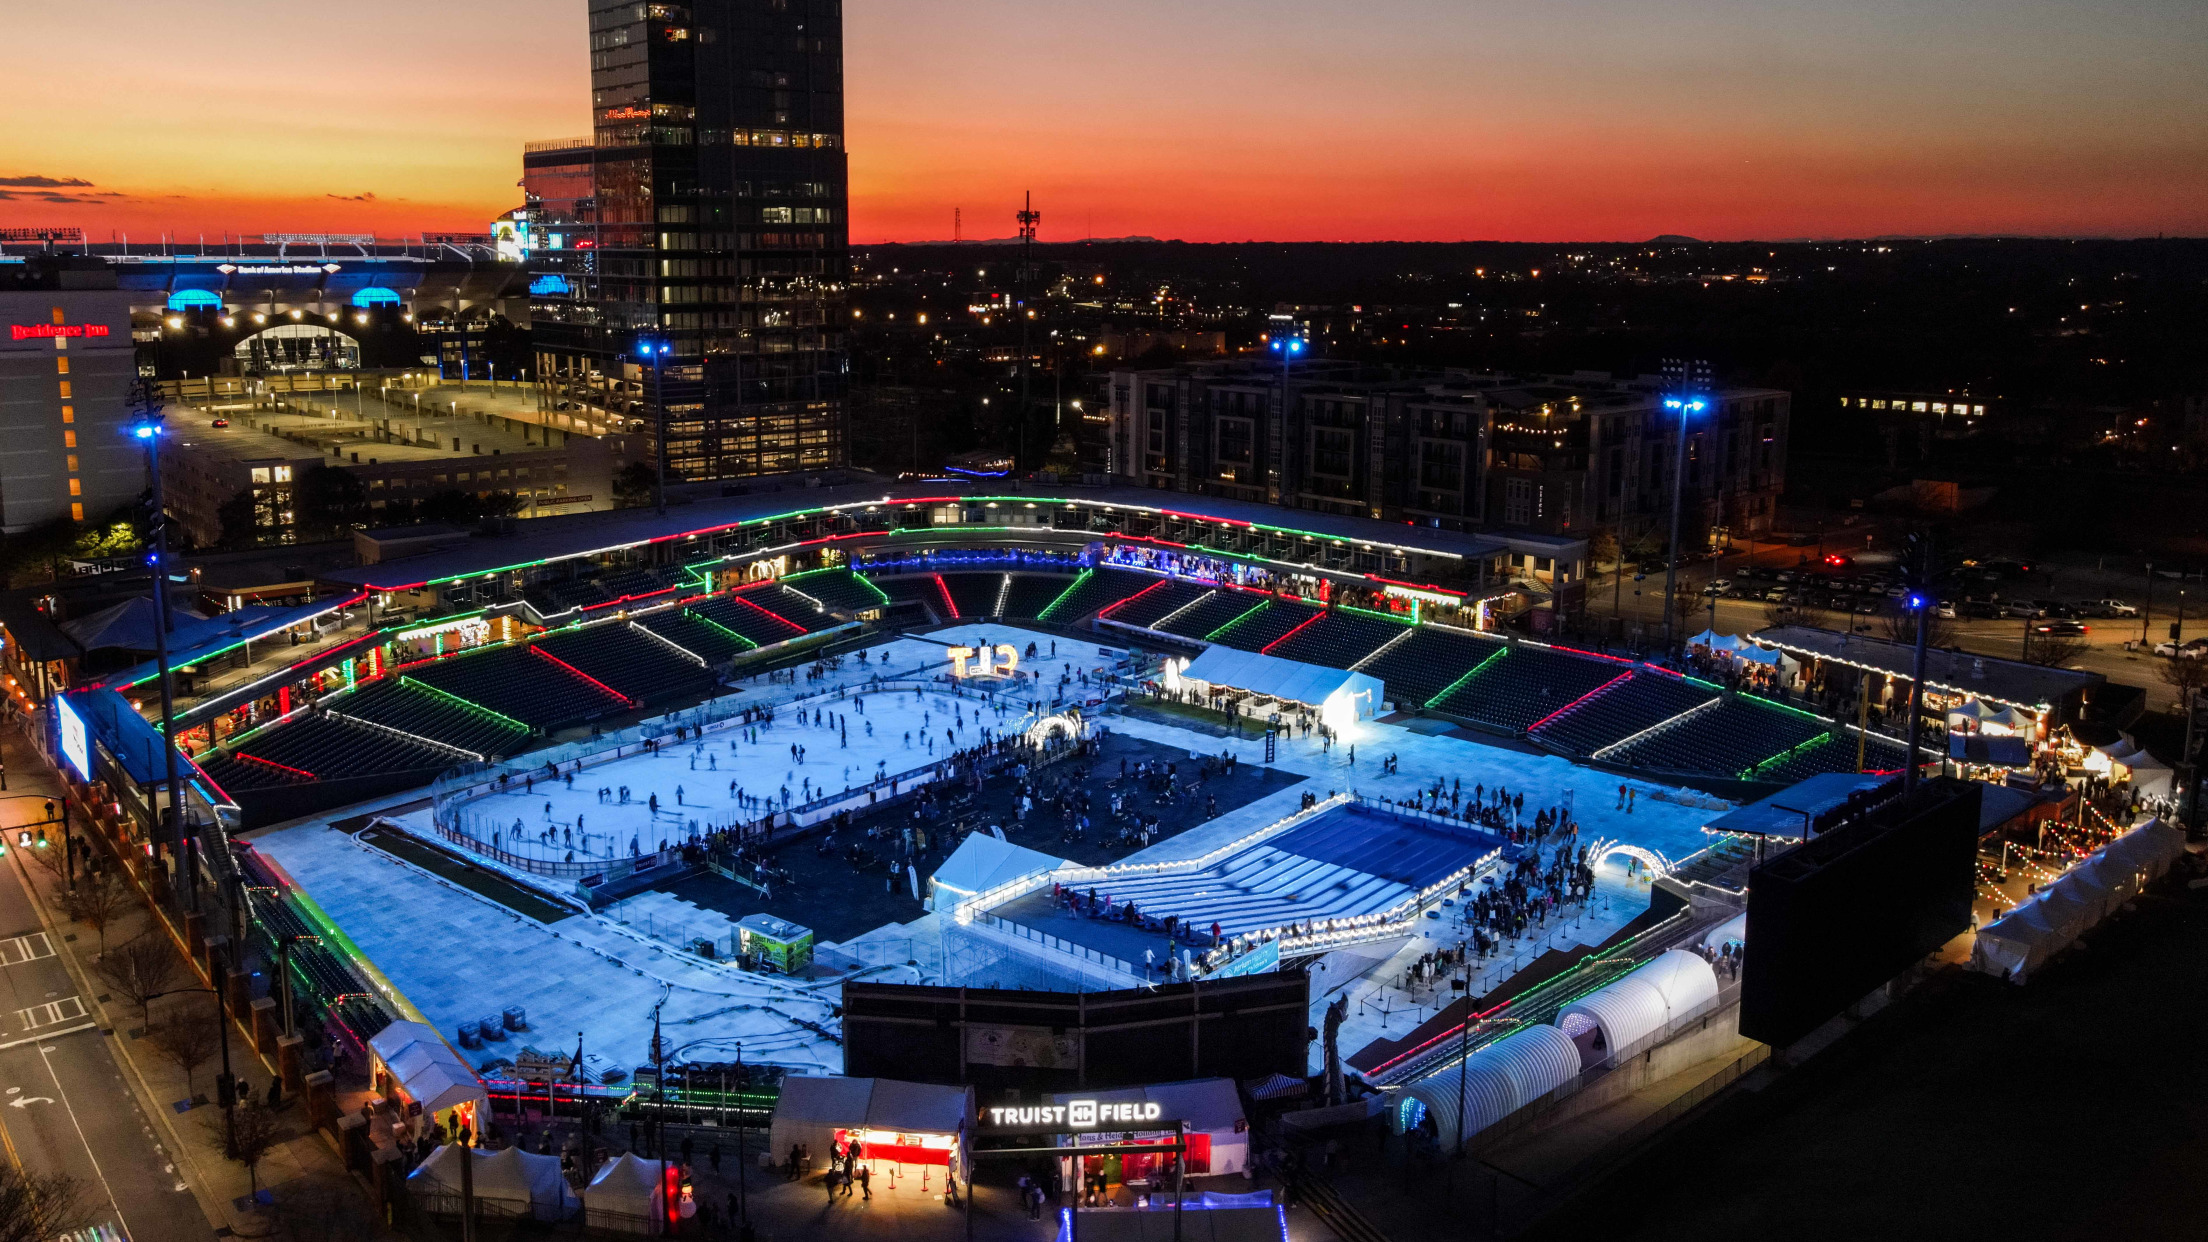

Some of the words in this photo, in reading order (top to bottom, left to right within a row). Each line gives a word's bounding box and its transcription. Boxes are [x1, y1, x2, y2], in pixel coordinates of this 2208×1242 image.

[238, 266, 256, 274] Bank
[256, 266, 264, 274] of
[264, 266, 293, 274] America
[293, 265, 322, 274] Stadium
[11, 324, 82, 340] Residence
[84, 323, 109, 338] Inn
[1234, 959, 1252, 974] Atrium
[1252, 950, 1269, 962] Health
[990, 1106, 1066, 1126] TRUIST
[1100, 1102, 1160, 1121] FIELD
